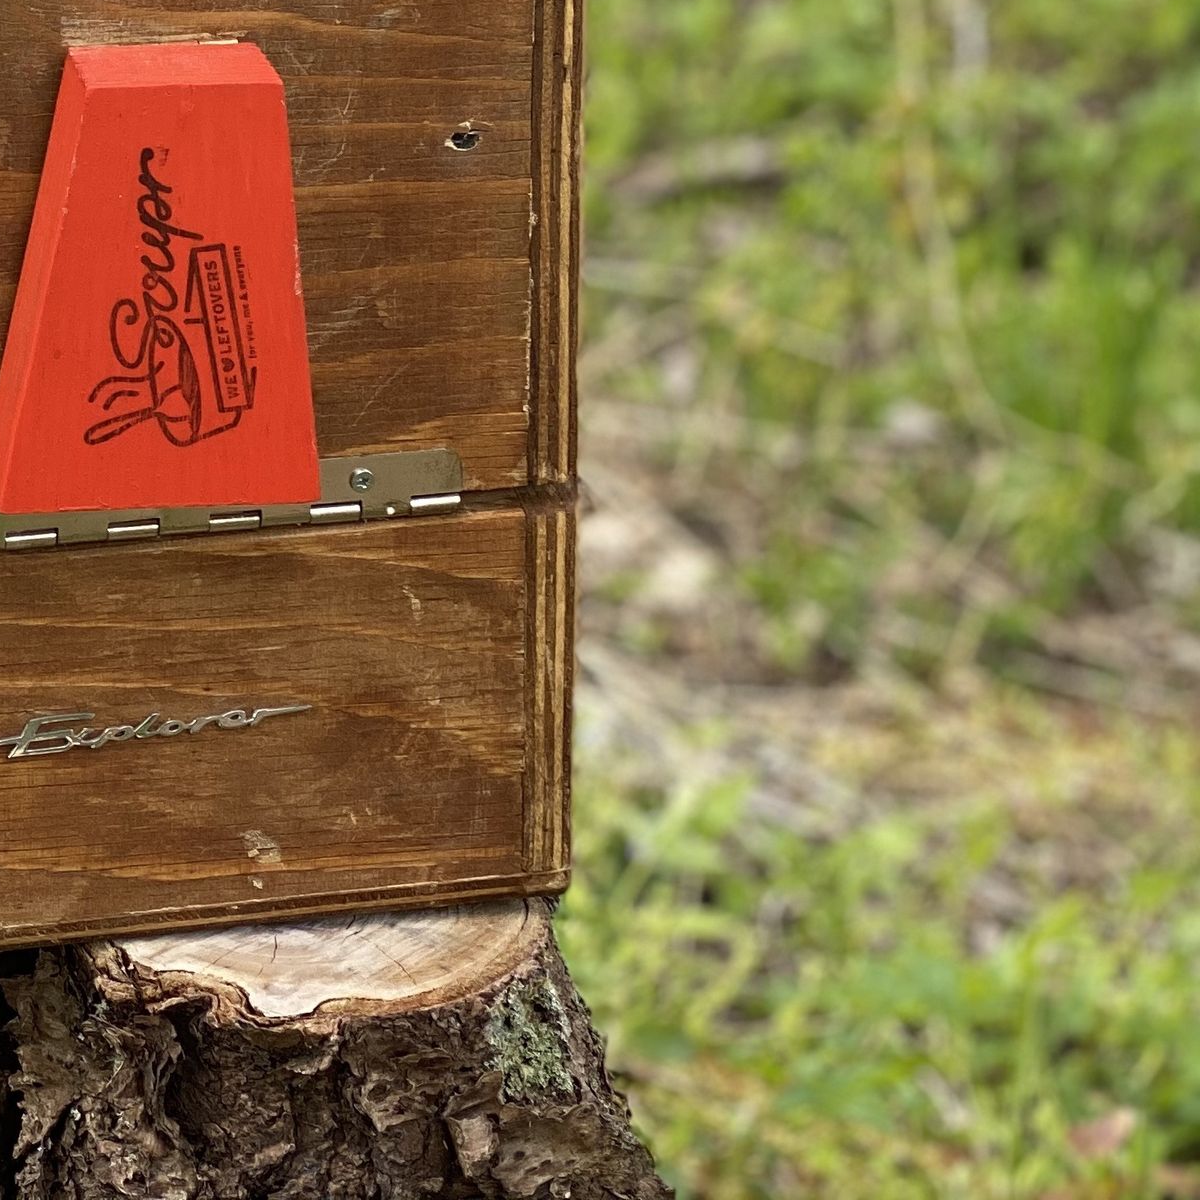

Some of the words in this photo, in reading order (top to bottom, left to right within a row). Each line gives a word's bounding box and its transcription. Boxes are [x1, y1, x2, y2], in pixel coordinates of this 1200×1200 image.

[109, 147, 204, 369] Soupr
[233, 245, 247, 290] everyone
[204, 260, 233, 355] LEFTOVERS
[242, 303, 251, 318] me
[248, 344, 257, 359] for
[223, 374, 242, 400] WE
